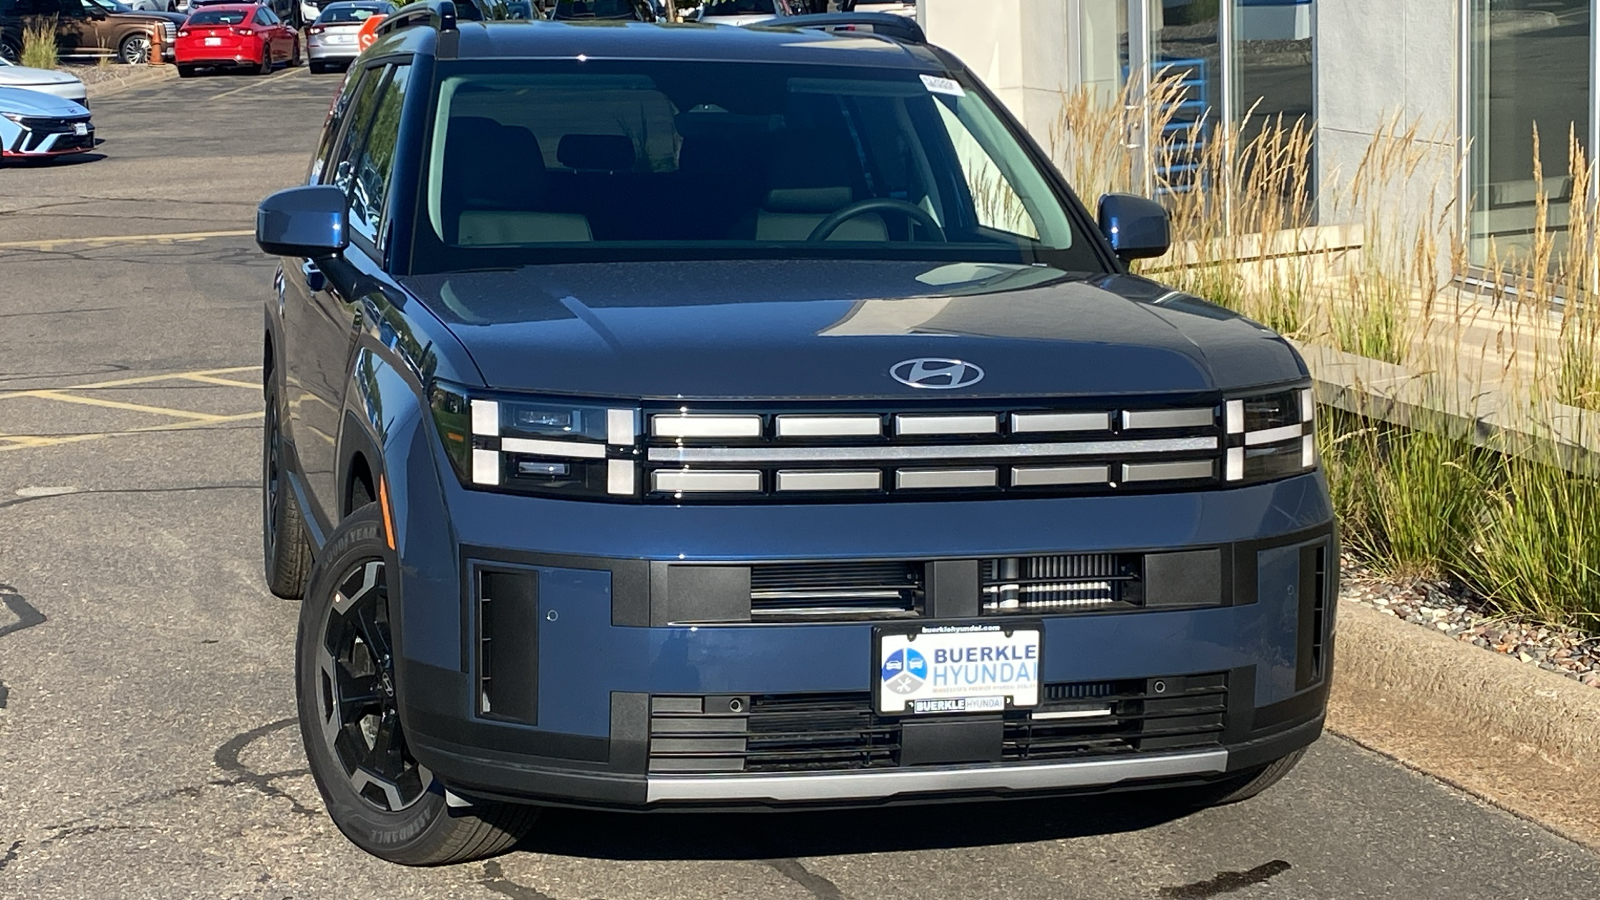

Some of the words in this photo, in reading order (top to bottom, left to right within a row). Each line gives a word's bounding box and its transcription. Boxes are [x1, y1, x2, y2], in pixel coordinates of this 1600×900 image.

[922, 625, 1001, 633] buerklehyundai.com
[934, 644, 1037, 664] BUERKLE
[933, 662, 1037, 686] HYUNDAI
[916, 699, 965, 712] BUERKLE
[966, 698, 1003, 708] HYUNDAI
